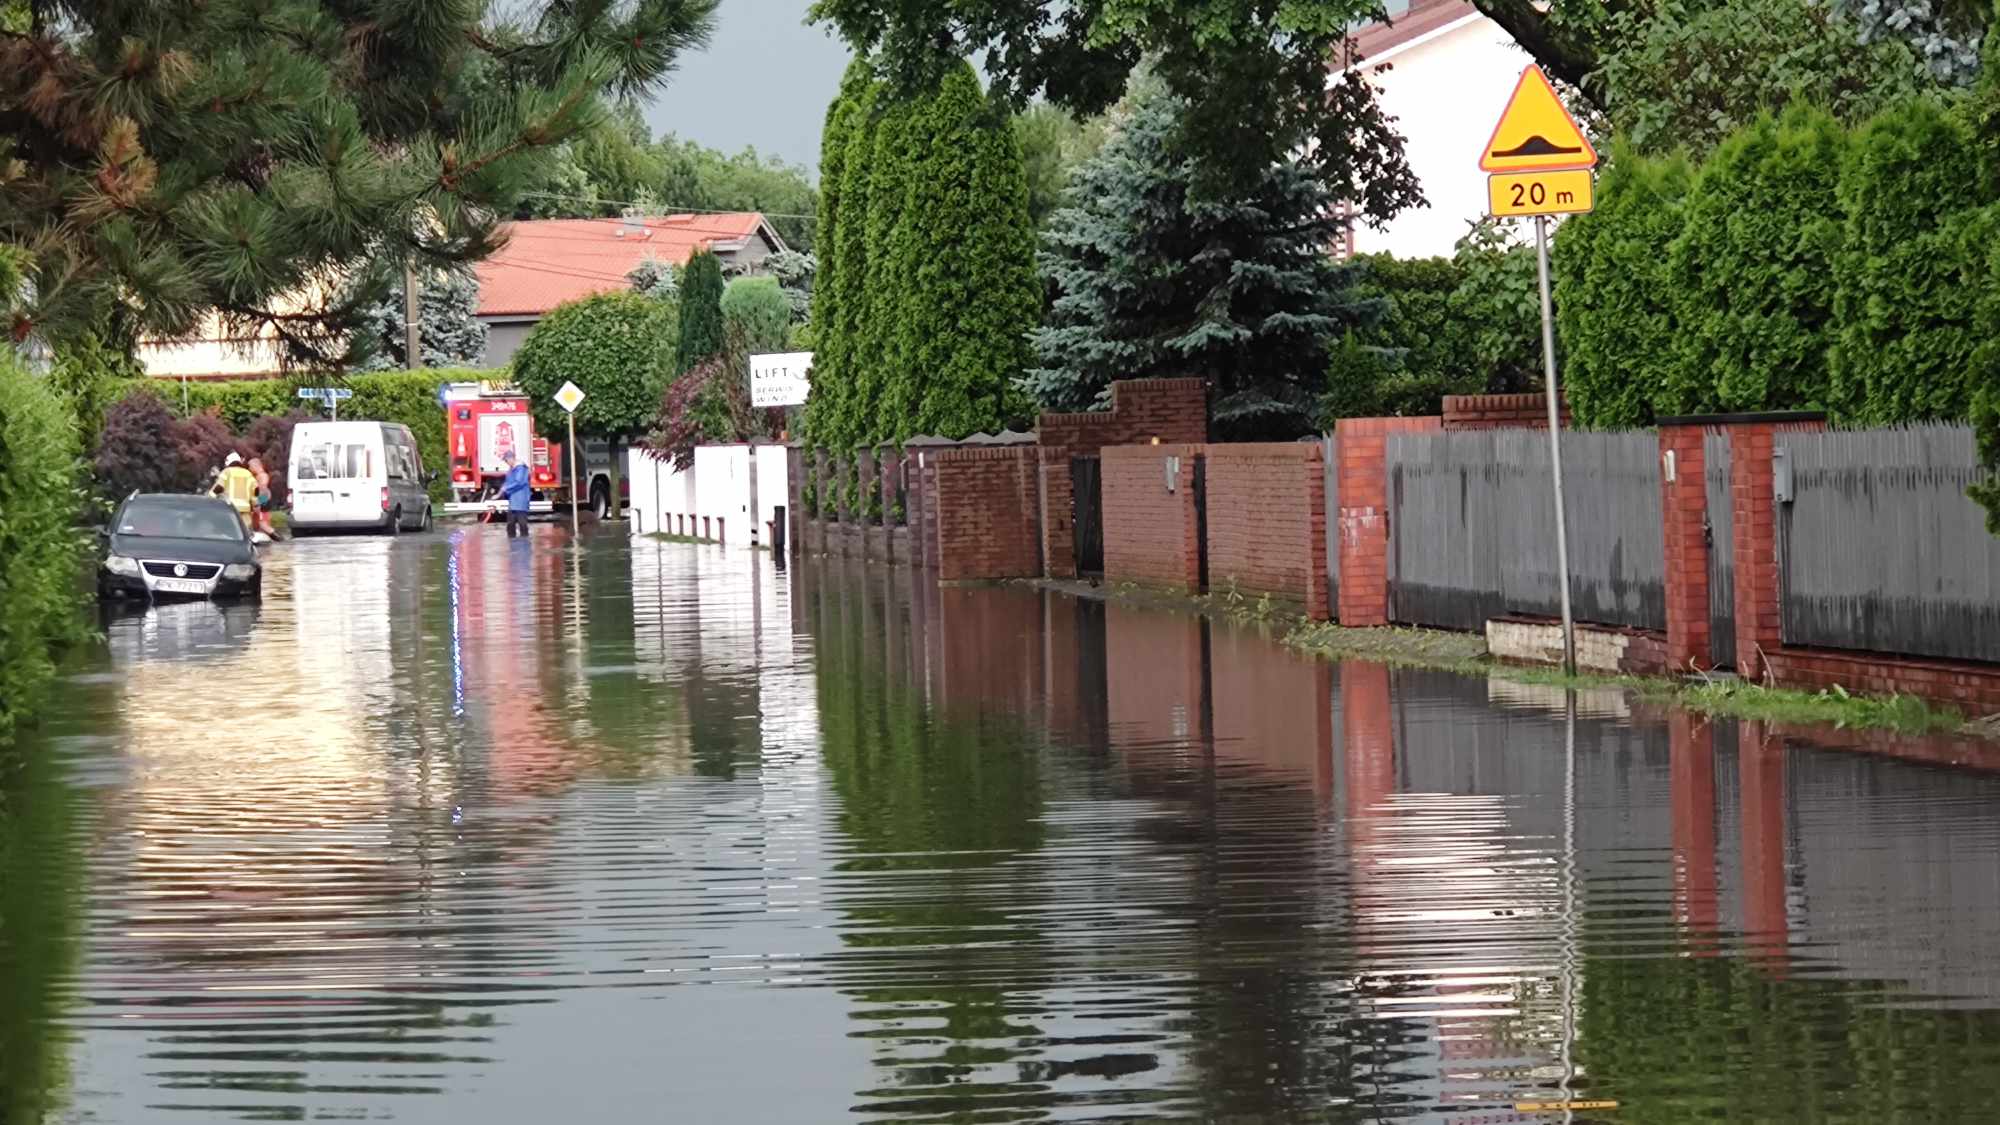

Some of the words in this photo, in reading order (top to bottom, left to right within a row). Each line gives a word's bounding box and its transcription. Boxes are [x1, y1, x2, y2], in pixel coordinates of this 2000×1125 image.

[1510, 182, 1546, 207] 20
[1556, 191, 1574, 204] m
[755, 367, 788, 379] LIFT
